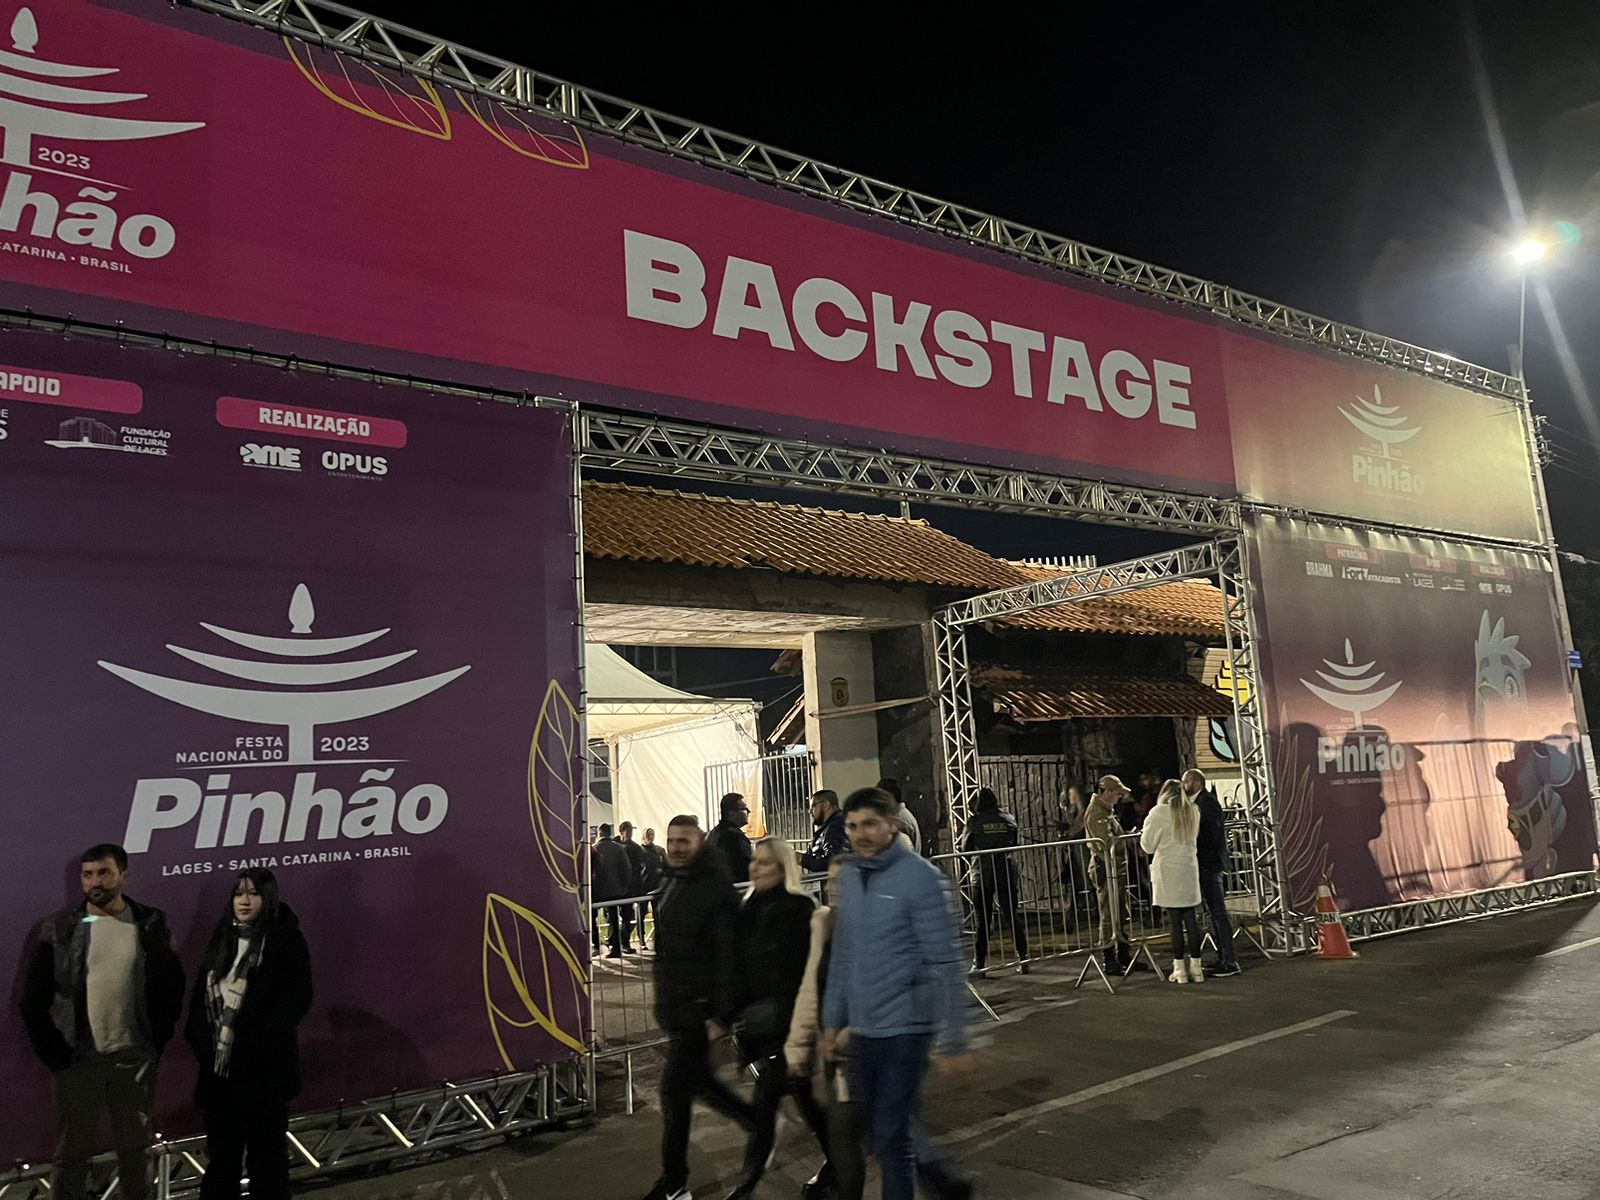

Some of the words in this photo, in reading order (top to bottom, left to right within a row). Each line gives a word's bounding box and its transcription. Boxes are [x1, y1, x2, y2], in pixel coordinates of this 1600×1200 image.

[38, 147, 91, 170] 2023
[80, 255, 132, 274] BRASIL
[623, 229, 1197, 429] BACKSTAGE
[259, 407, 370, 437] REALIZAÇÃO
[322, 451, 388, 475] OPUS
[1352, 454, 1425, 496] Pinhão
[236, 736, 284, 748] FESTA
[320, 736, 370, 752] 2023
[1317, 734, 1406, 774] Pinhão
[176, 750, 258, 763] NACIONAL
[262, 749, 283, 760] DO
[123, 767, 449, 854] Pinhão
[162, 861, 213, 876] LAGES
[228, 857, 279, 871] SANTA
[282, 850, 352, 866] CATARINA
[364, 846, 412, 859] BRASIL
